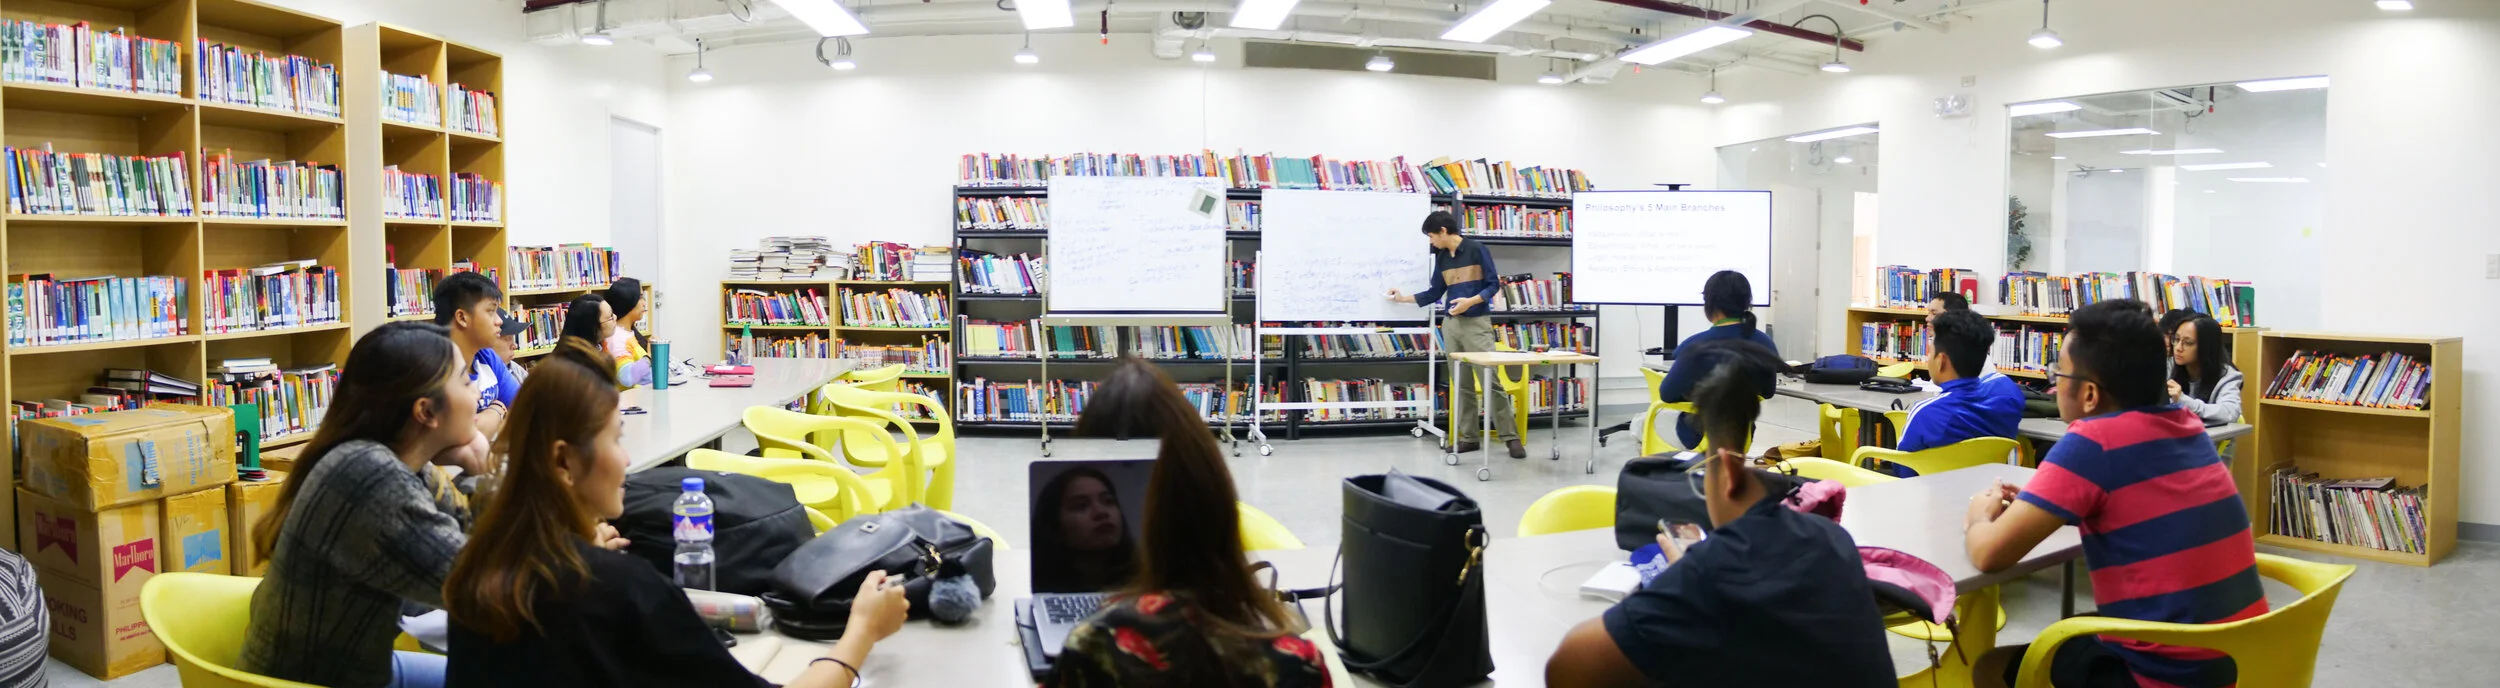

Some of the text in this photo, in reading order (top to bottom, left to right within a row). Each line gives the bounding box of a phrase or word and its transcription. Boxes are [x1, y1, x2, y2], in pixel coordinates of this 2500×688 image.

[1585, 203, 1726, 213] Philosophy's 5 Main Branches
[114, 545, 154, 568] Marlboro
[48, 597, 88, 624] OKING
[51, 619, 77, 642] ILLS
